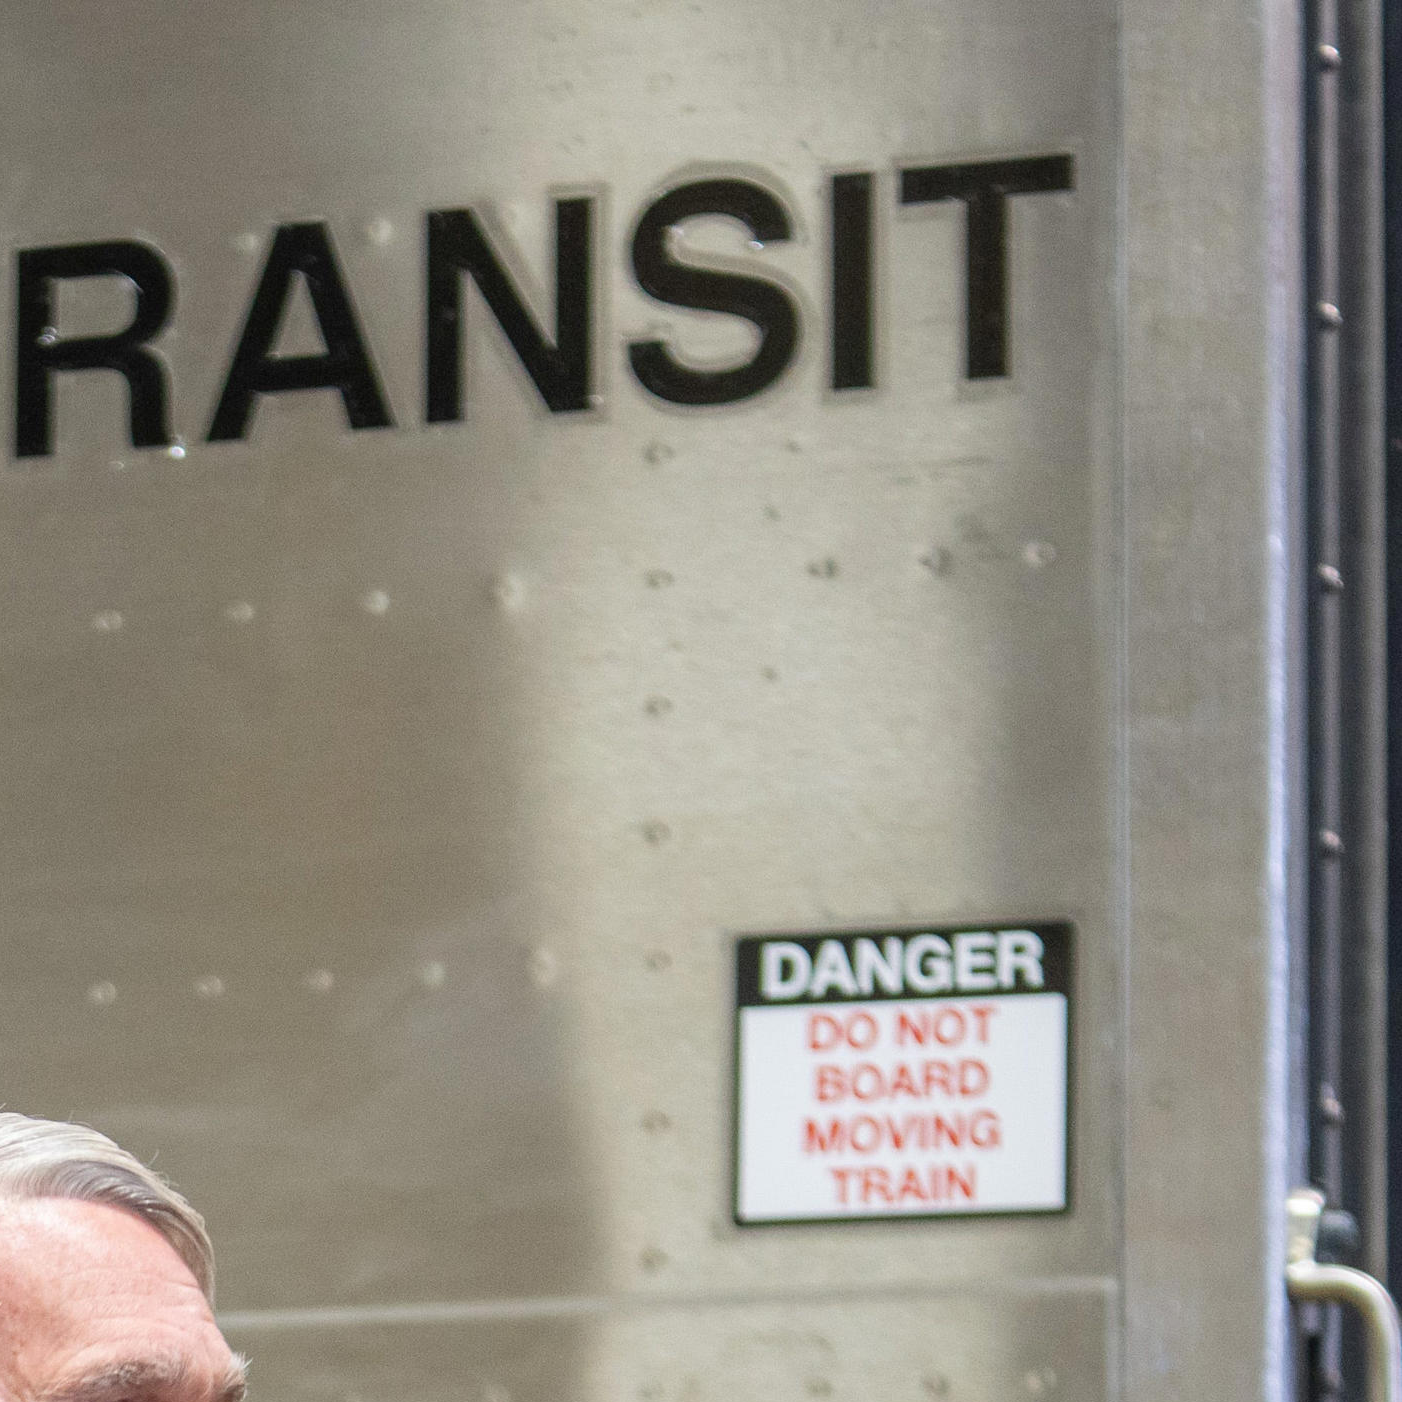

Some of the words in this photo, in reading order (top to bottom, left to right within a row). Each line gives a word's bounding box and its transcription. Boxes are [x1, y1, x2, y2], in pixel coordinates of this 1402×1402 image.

[761, 930, 1045, 999] DANGER
[808, 1012, 878, 1051] DO
[897, 1006, 995, 1046] NOT
[816, 1059, 990, 1102] BOARD
[805, 1111, 1001, 1153] MOVING
[830, 1165, 976, 1203] TRAIN
